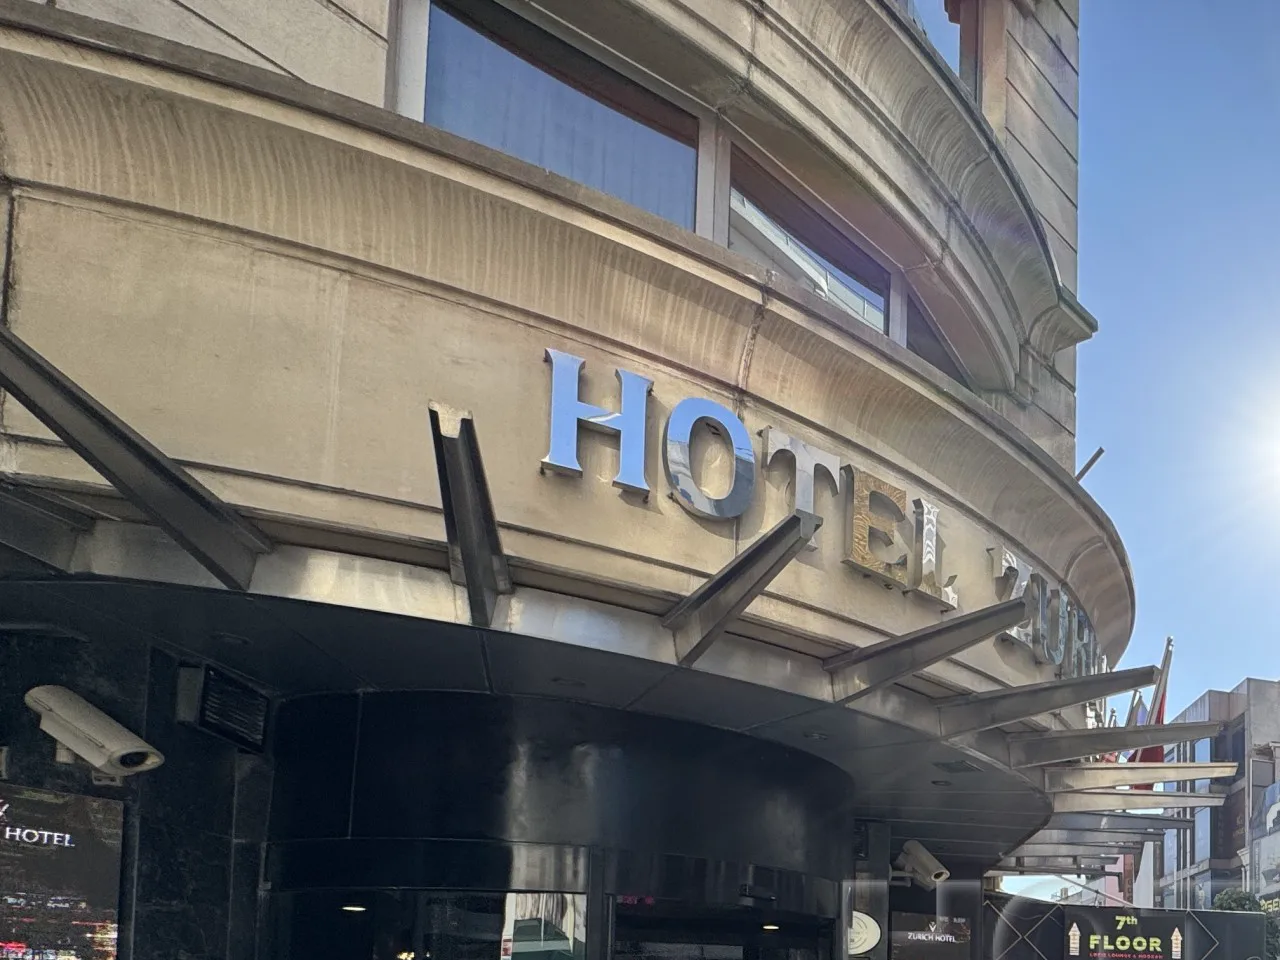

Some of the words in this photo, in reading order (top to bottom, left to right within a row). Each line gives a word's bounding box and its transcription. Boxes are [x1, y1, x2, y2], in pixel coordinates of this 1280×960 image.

[541, 348, 958, 611] HOTEL
[5, 827, 75, 847] HOTEL
[1115, 915, 1138, 930] 7th
[908, 932, 934, 941] ZURICH
[1089, 934, 1162, 952] FLOOR
